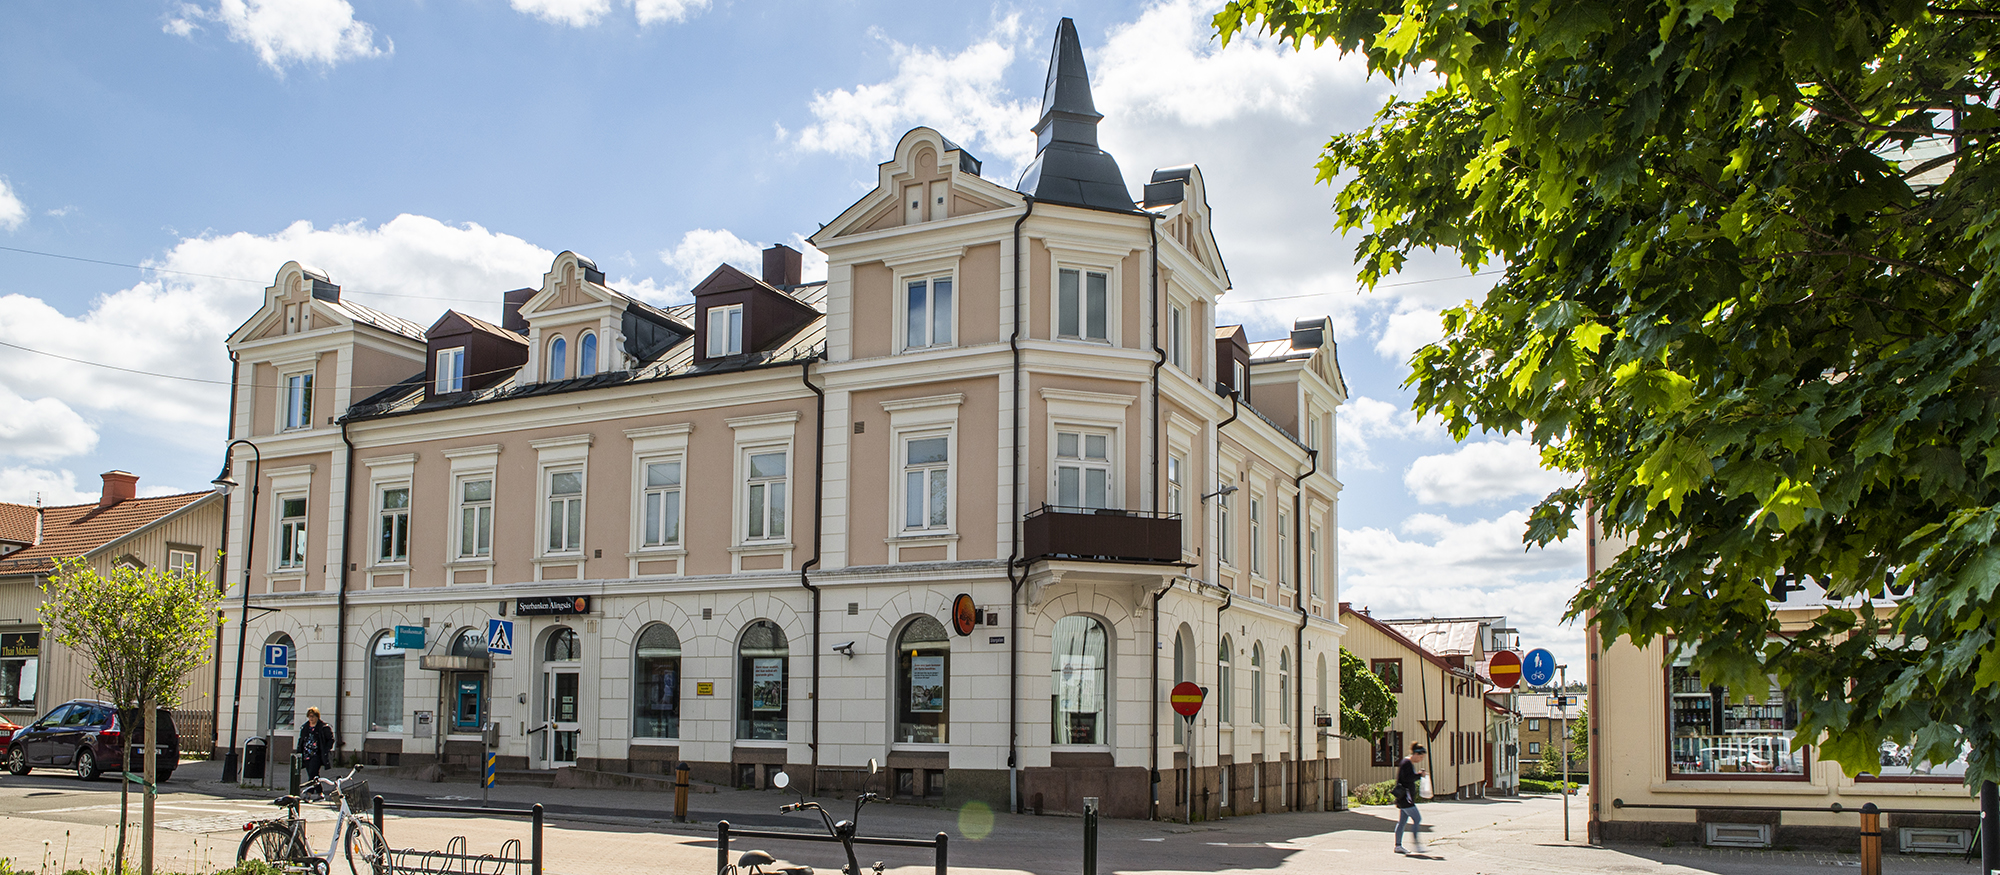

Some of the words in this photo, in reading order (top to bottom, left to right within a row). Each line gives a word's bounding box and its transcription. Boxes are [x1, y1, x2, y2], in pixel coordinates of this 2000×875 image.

[519, 602, 549, 612] Sparbanken
[2, 646, 14, 656] Thai
[271, 646, 283, 664] P
